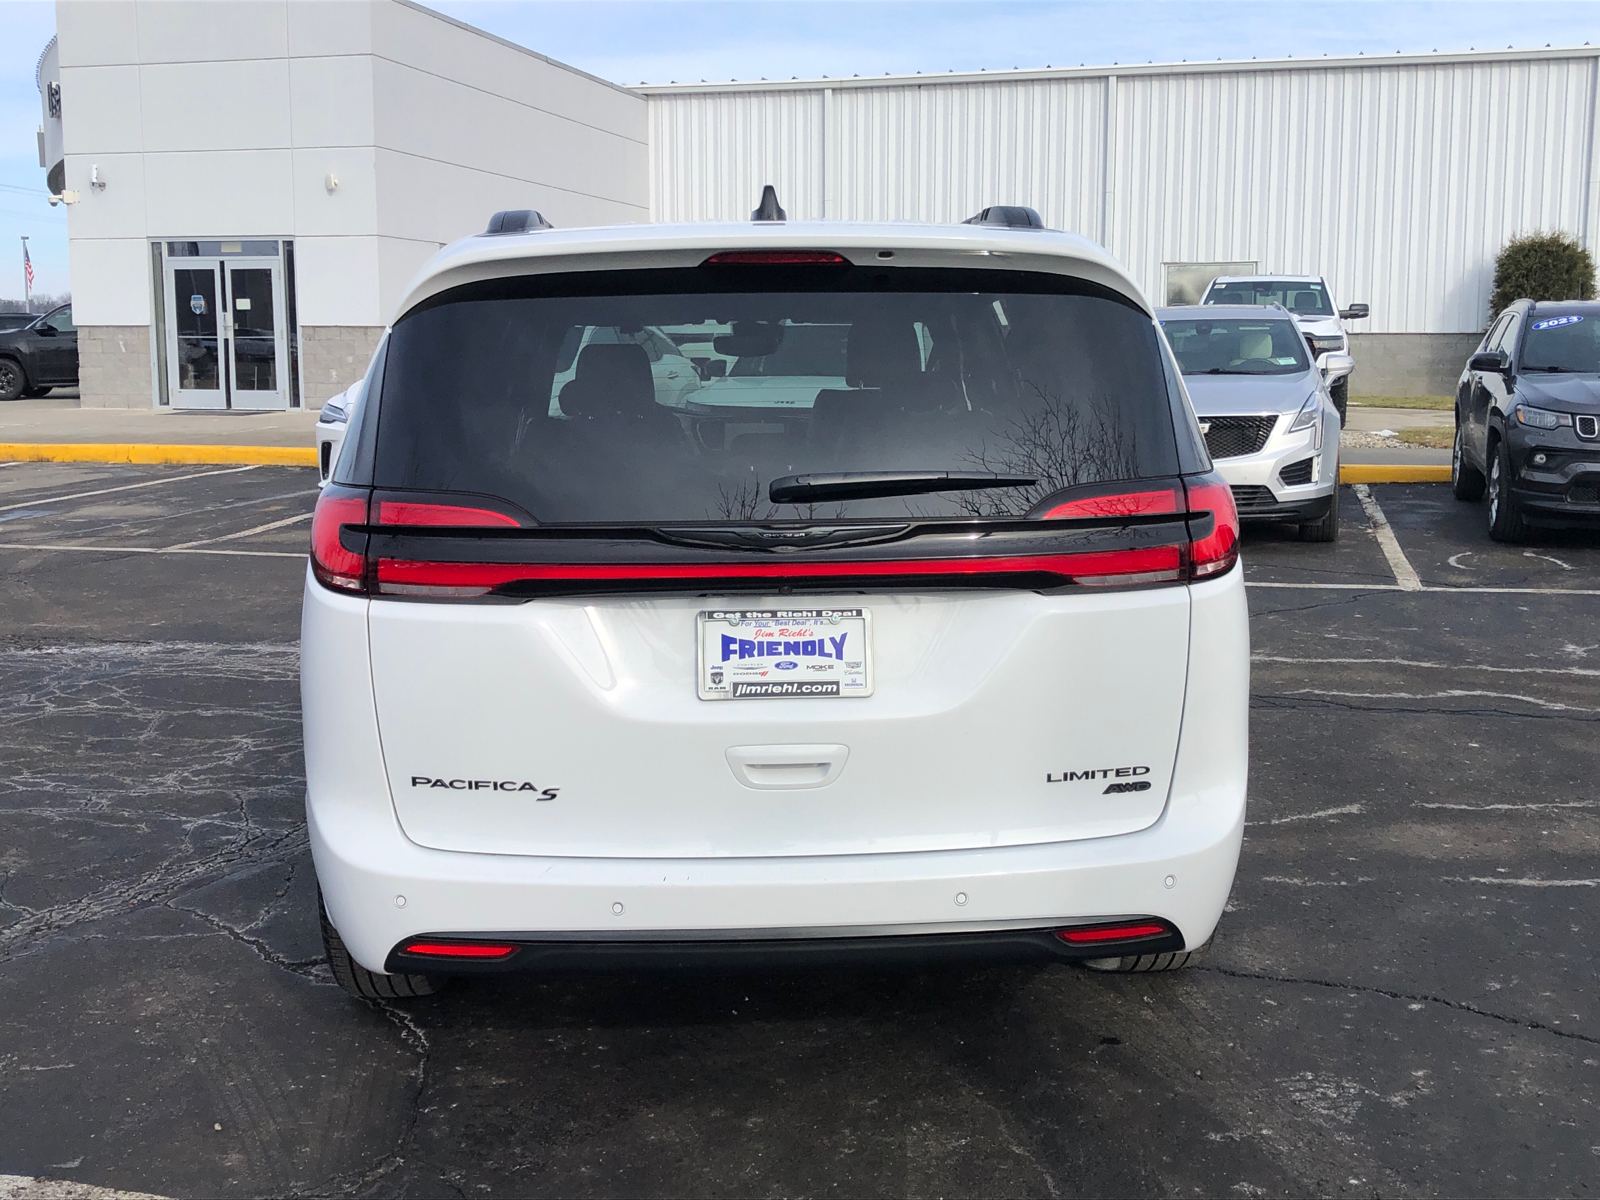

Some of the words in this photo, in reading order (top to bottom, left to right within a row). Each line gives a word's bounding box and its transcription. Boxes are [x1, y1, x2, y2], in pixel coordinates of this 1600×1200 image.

[1539, 316, 1579, 329] 2023
[712, 611, 742, 619] Get
[776, 610, 817, 618] Riehl
[821, 610, 857, 618] Deal
[754, 620, 771, 628] Your
[753, 628, 776, 640] Jim
[777, 628, 814, 638] Riehl's
[721, 632, 849, 663] FRIENDLY
[735, 683, 838, 696] jimriehl.com
[1046, 766, 1151, 783] LIMITED
[411, 776, 538, 792] PACIFICA
[535, 787, 561, 802] S
[1102, 781, 1152, 795] AWD
